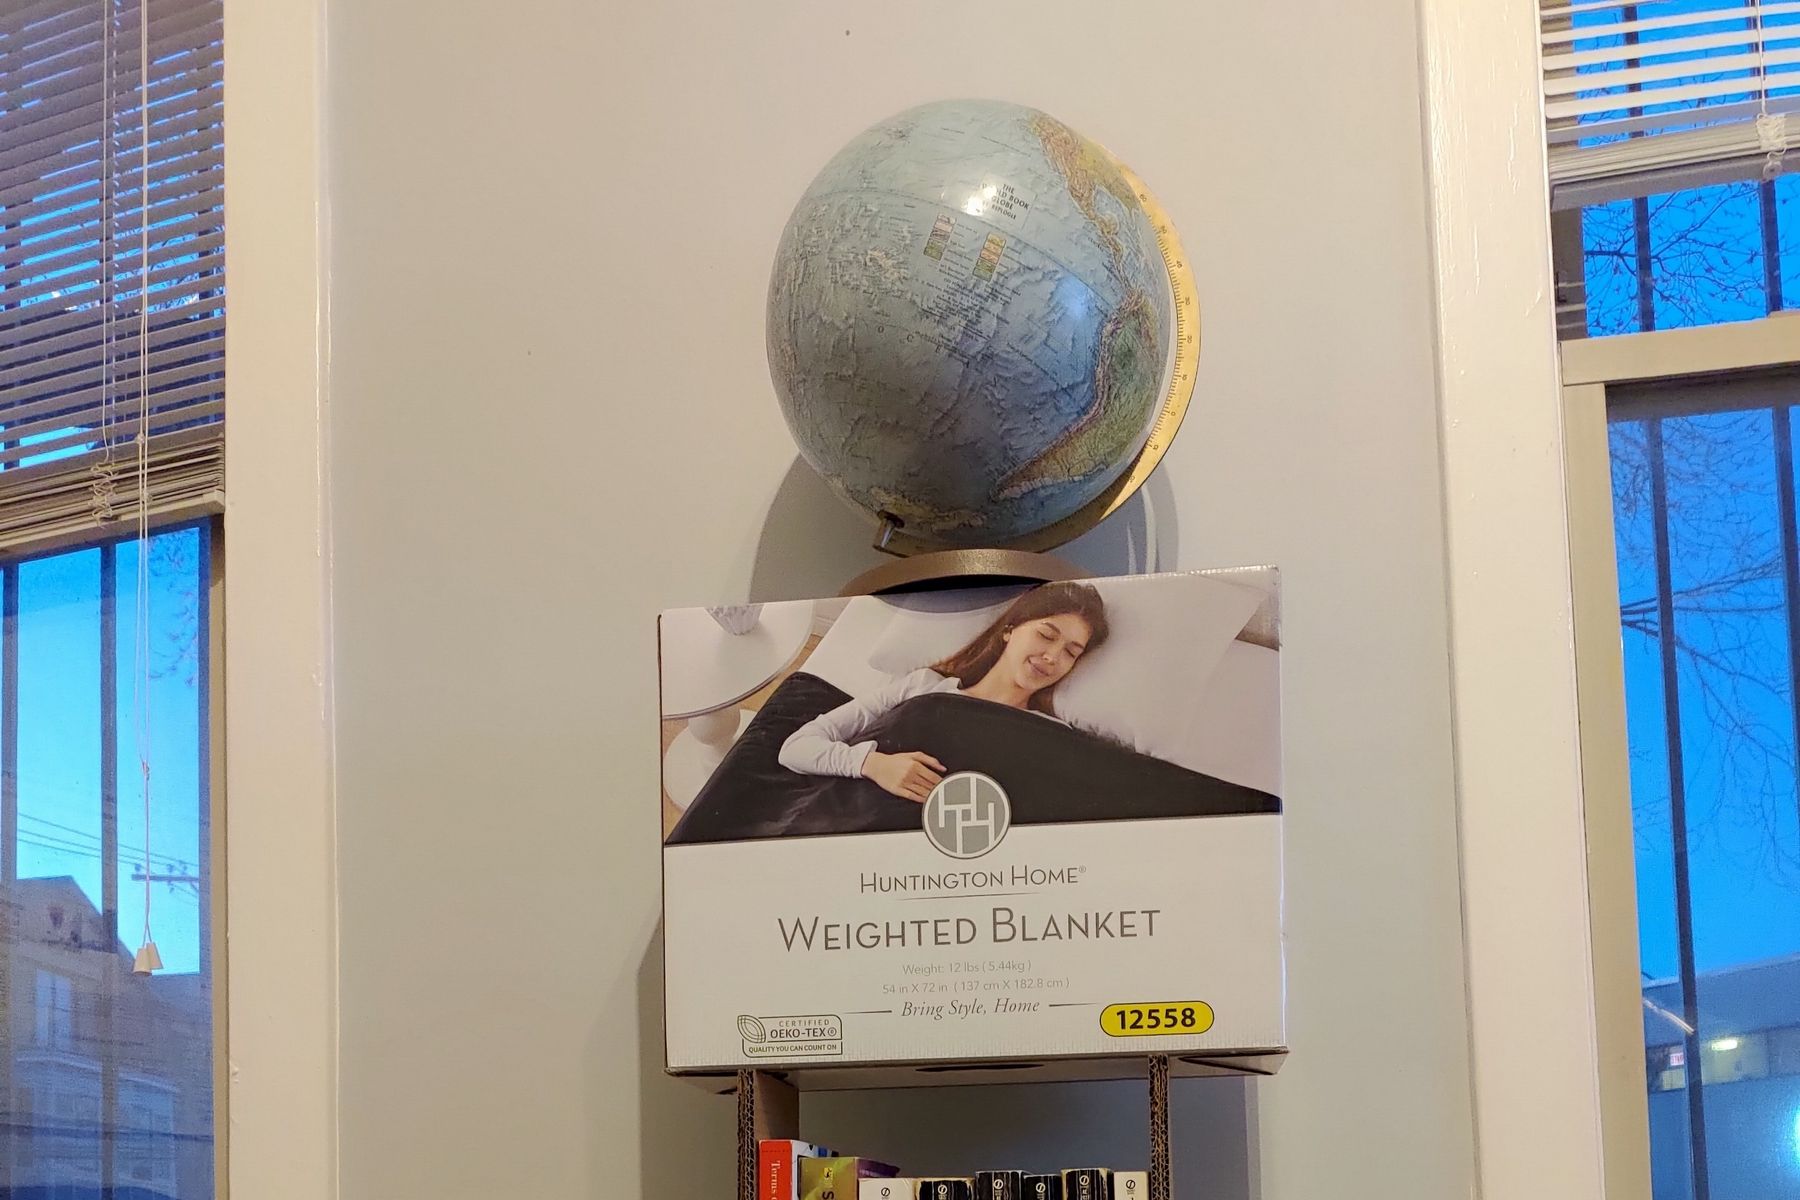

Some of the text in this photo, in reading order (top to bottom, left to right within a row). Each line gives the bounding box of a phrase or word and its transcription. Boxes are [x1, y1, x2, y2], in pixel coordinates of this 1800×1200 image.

[1008, 194, 1030, 210] BOOK
[860, 870, 1003, 894] HUNTINGTON
[777, 906, 1162, 954] WEIGHTED BLANKET
[949, 962, 962, 973] 12
[964, 961, 980, 973] lbs
[882, 984, 896, 995] 54
[899, 984, 909, 994] in
[923, 982, 936, 993] 72
[938, 981, 948, 992] in
[983, 982, 1000, 992] cm
[1014, 977, 1044, 989] 182.8
[901, 997, 1041, 1021] Bring Style, Home
[1115, 1006, 1198, 1032] 12558
[778, 1018, 830, 1028] CERTIFIED
[748, 1046, 775, 1054] QUALITY
[769, 1160, 781, 1195] Terms
